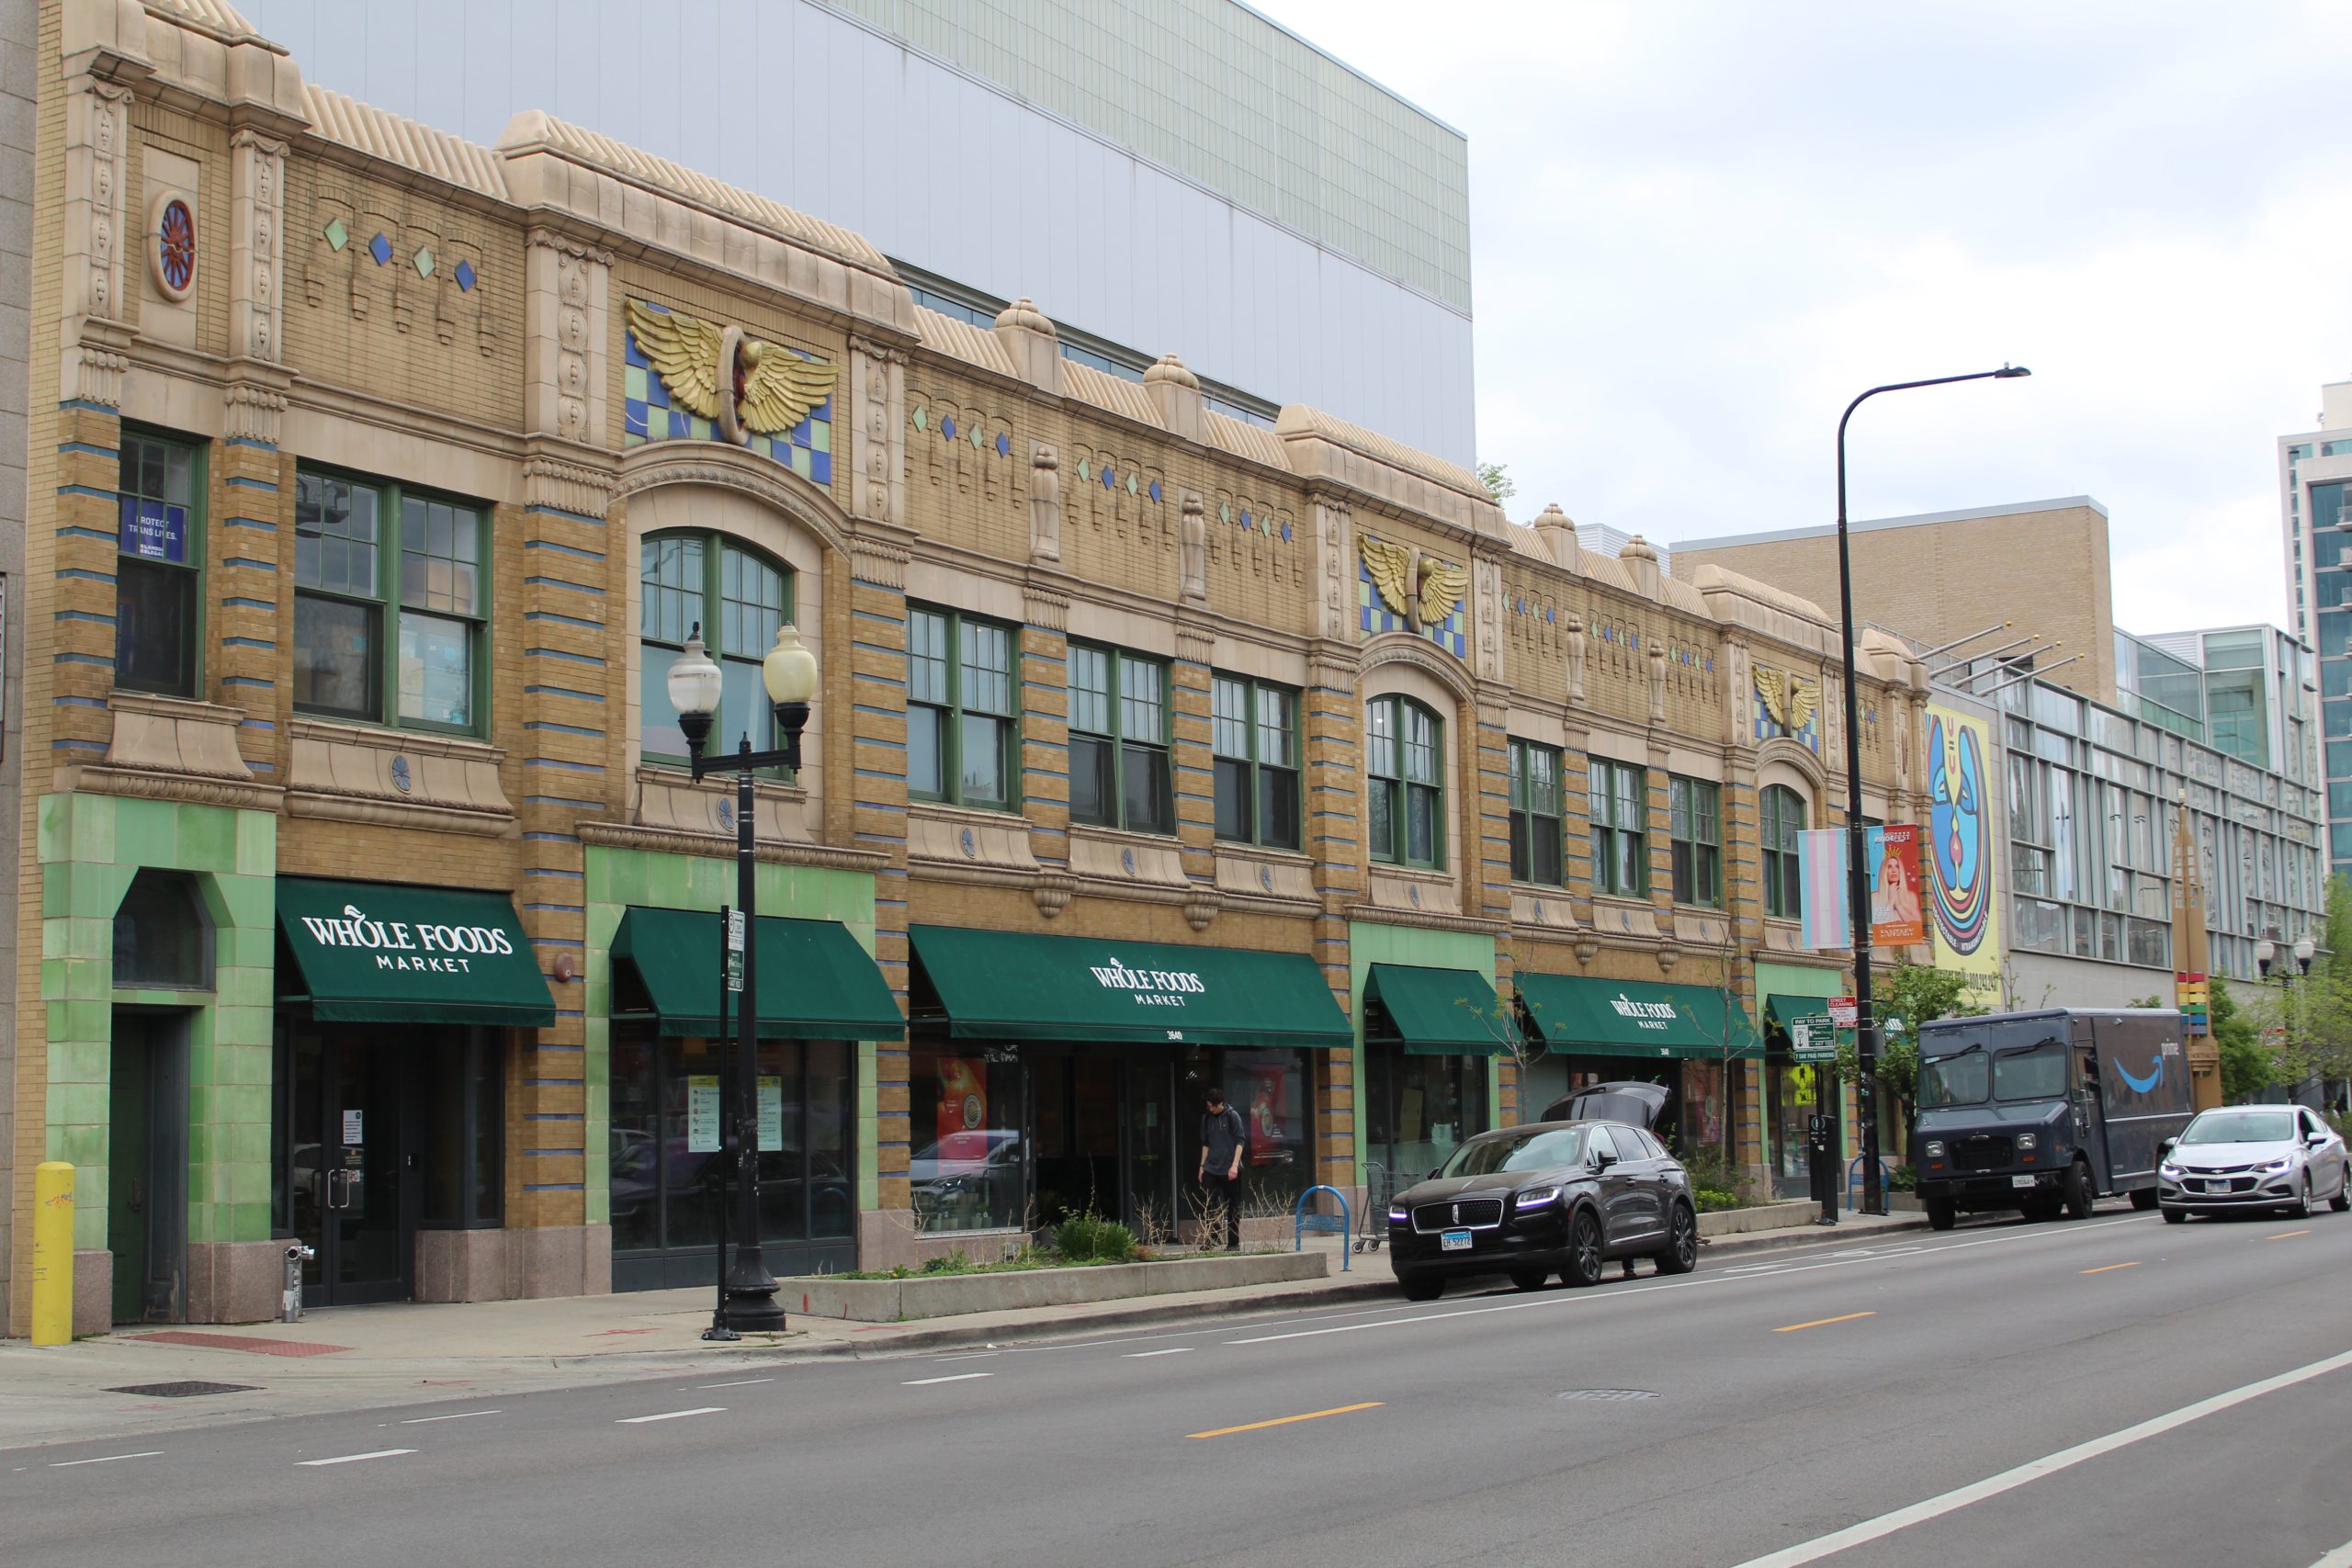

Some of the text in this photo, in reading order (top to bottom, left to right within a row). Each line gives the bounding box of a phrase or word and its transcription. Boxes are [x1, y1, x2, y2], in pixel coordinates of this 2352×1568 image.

[129, 525, 153, 536] TRANS
[301, 909, 513, 954] WHOLE FOODS
[376, 955, 469, 973] MARKET
[1090, 963, 1205, 992] WHOLE FOODS
[1134, 994, 1185, 1006] MARKET
[1610, 998, 1677, 1019] WHOLE FOODS
[1637, 1021, 1668, 1029] MARKET
[1167, 1031, 1182, 1040] 3640
